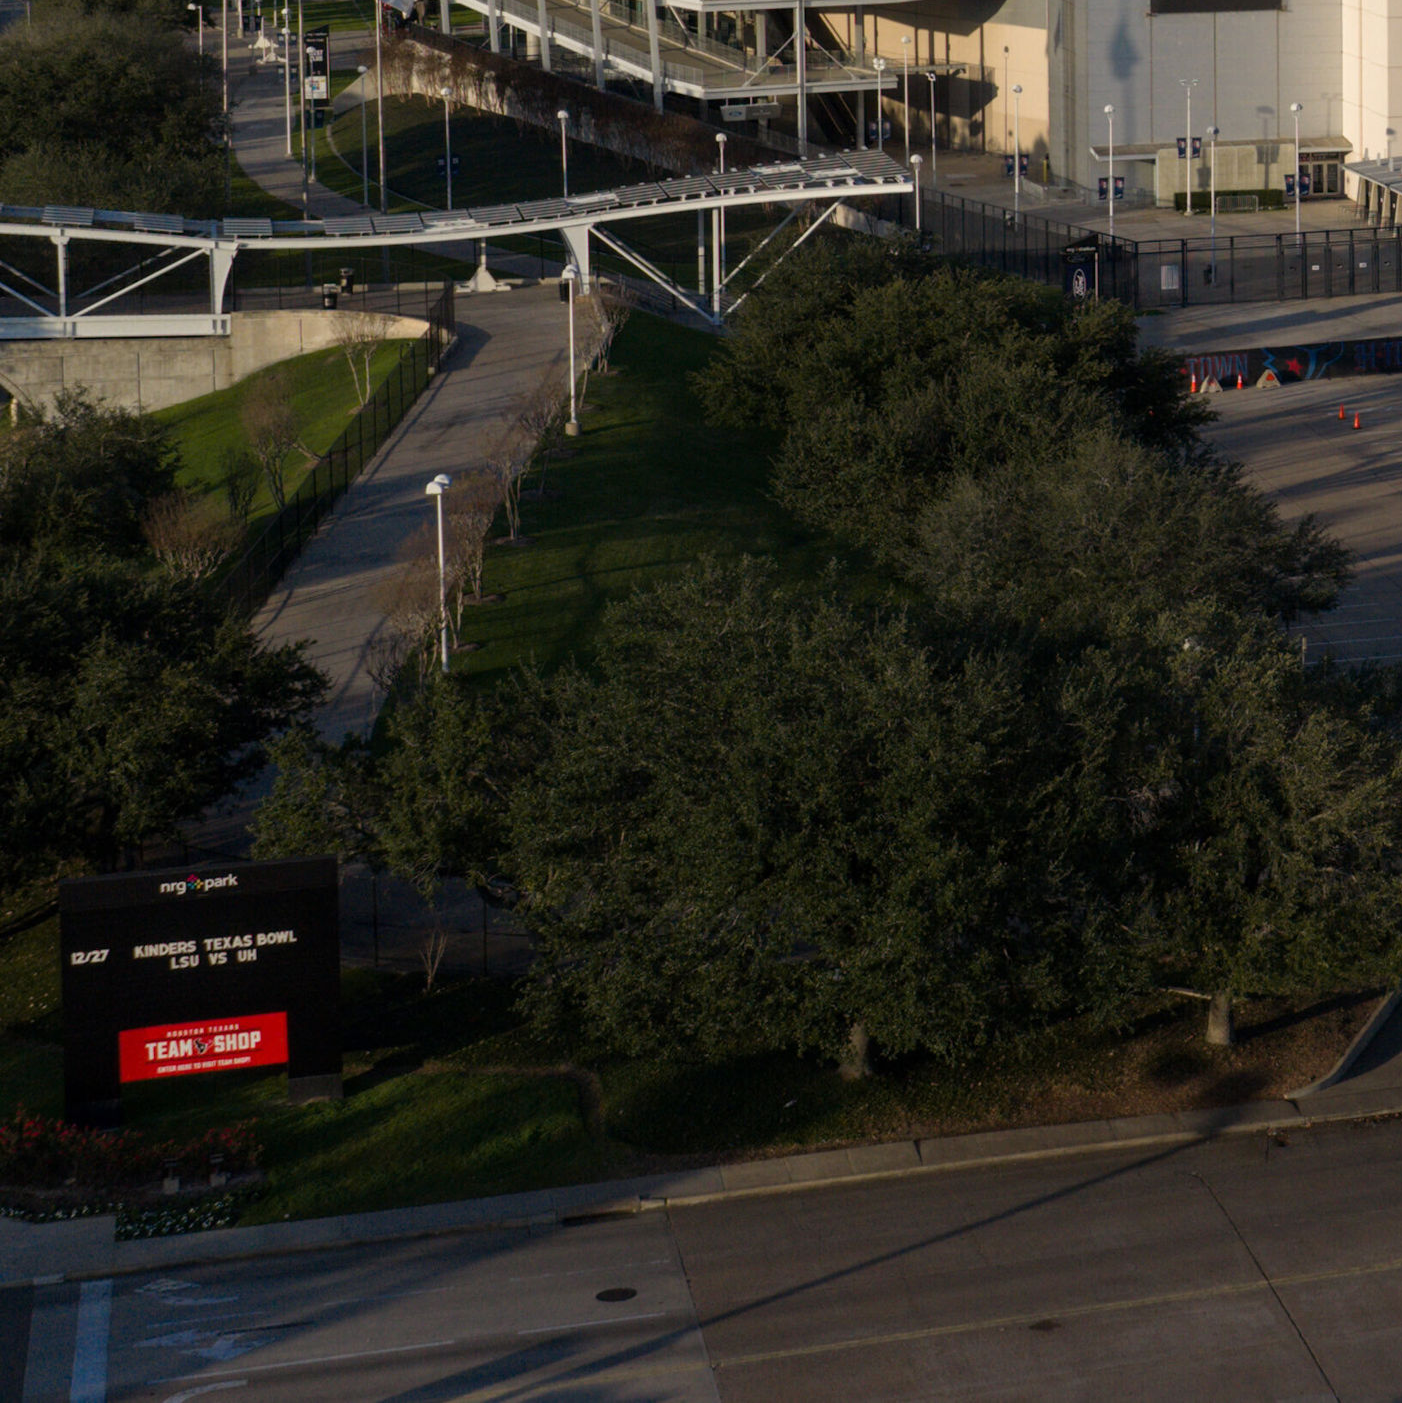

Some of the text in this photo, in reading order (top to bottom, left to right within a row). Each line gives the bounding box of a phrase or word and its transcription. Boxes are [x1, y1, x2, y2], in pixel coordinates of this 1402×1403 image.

[159, 873, 238, 895] nrg park
[133, 930, 297, 960] KINDERS TEXAS BOWL
[70, 949, 110, 966] 12/27
[170, 948, 257, 970] LSU VS UH
[144, 1030, 262, 1062] TEAM SHOP
